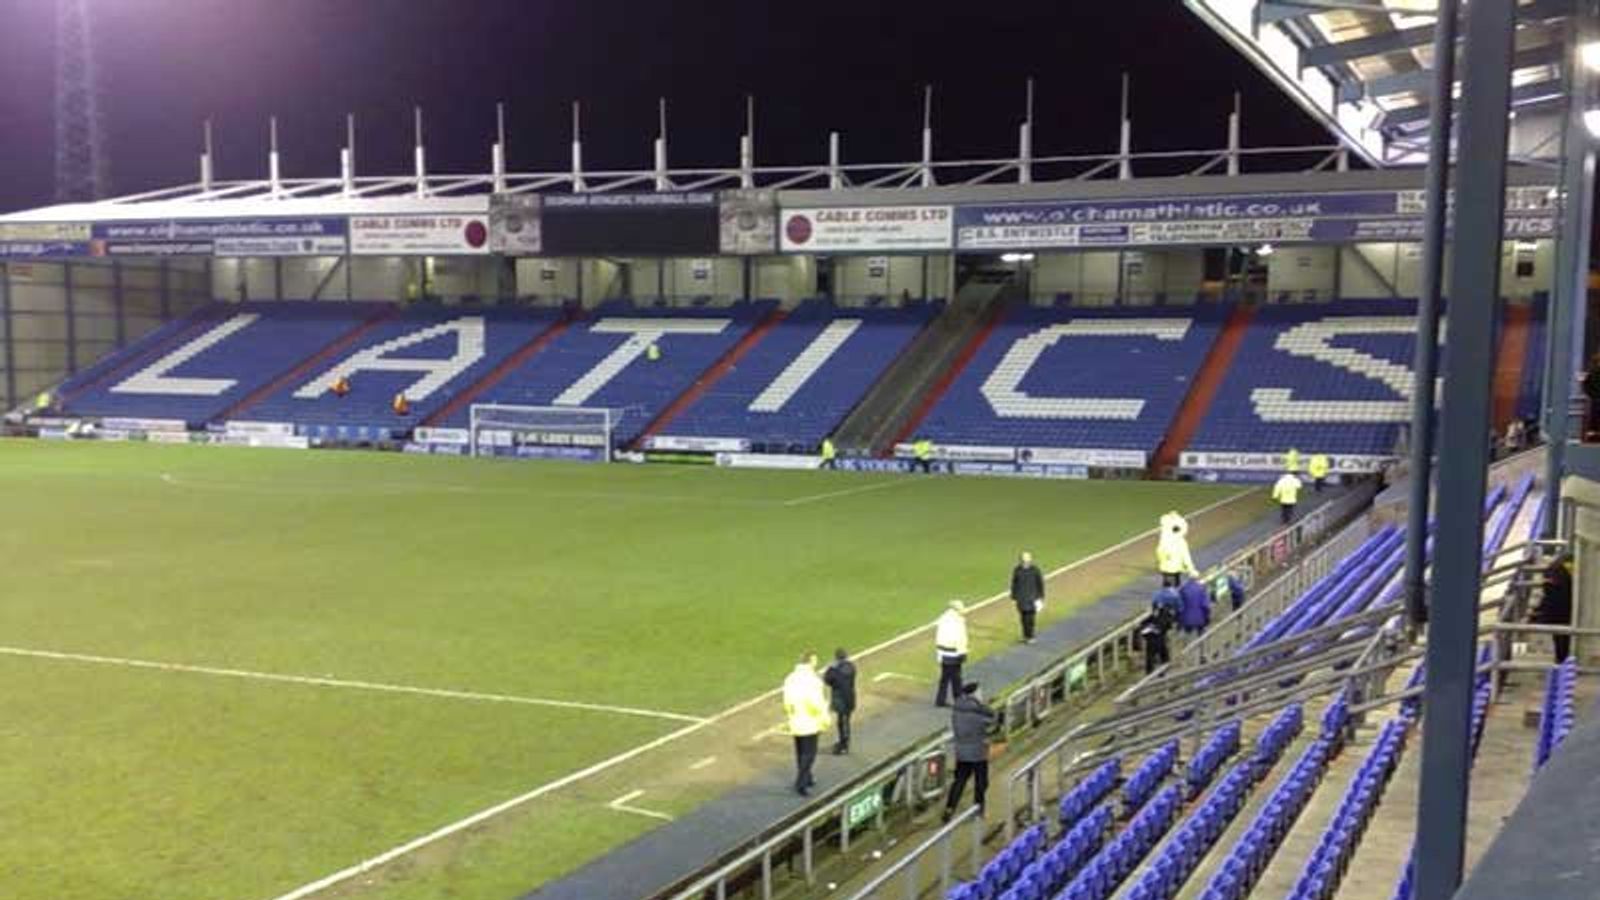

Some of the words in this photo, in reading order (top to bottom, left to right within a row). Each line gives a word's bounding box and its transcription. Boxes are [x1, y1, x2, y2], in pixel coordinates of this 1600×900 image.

[816, 210, 861, 223] CABLE
[865, 209, 918, 222] COMMS
[921, 208, 948, 221] LTD
[354, 218, 390, 230] CABLE
[440, 217, 463, 228] LTD
[109, 313, 1447, 422] LATICS
